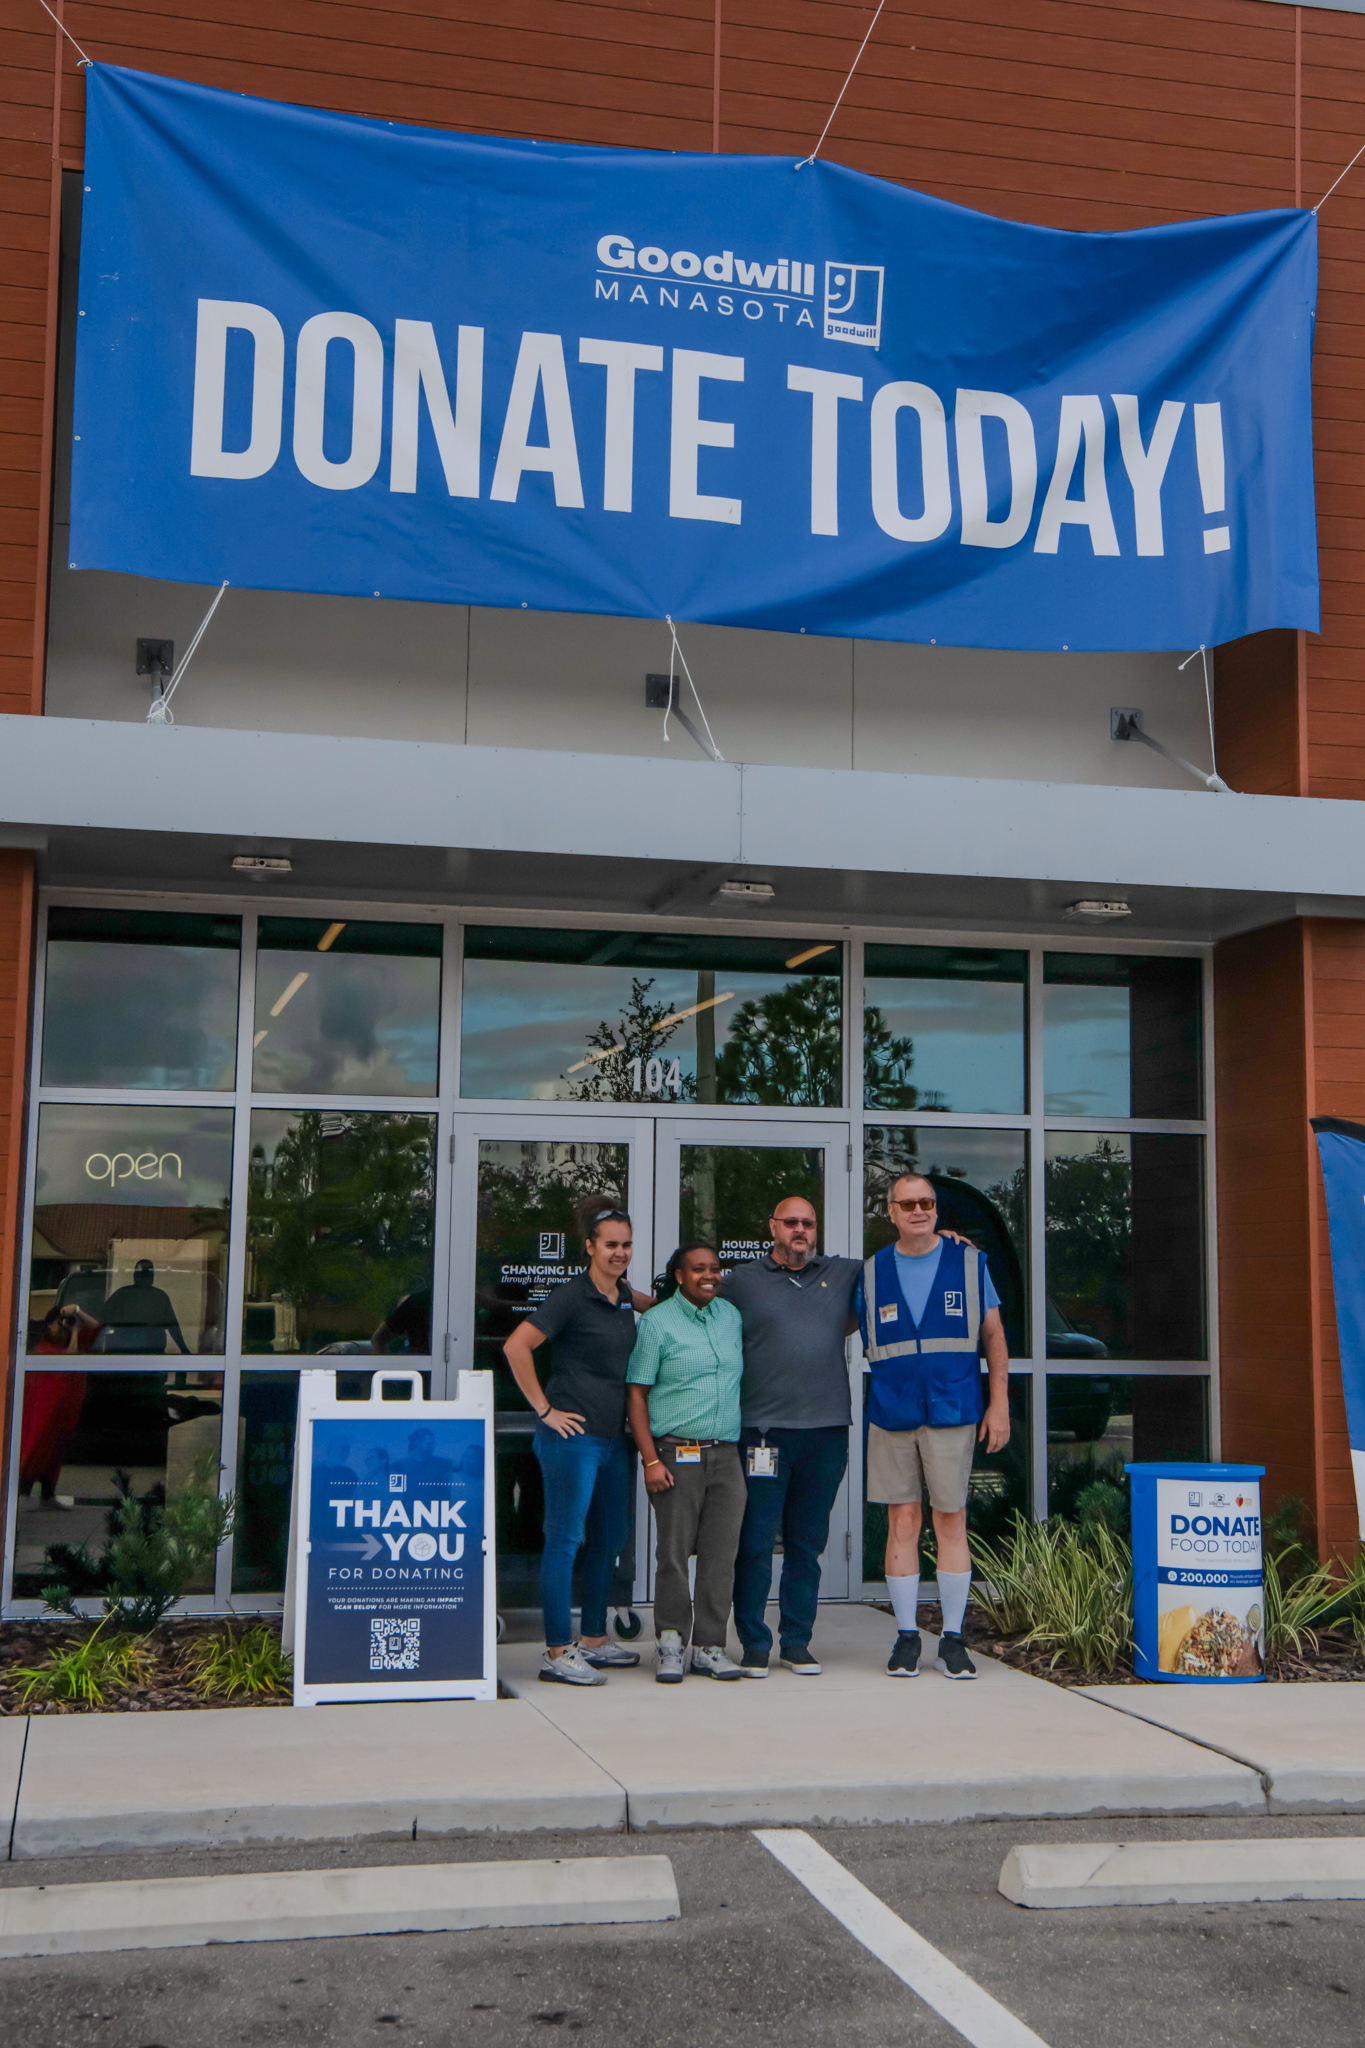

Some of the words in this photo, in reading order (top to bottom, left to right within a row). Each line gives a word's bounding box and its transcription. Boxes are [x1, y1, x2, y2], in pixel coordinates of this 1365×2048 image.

[596, 234, 815, 296] Goodwill
[595, 279, 814, 329] MANASOTA
[827, 324, 877, 339] goodwill
[190, 298, 745, 525] DONATE
[787, 364, 1231, 556] TODAY!
[625, 1057, 682, 1094] 104
[85, 1152, 182, 1187] open
[722, 1240, 760, 1249] HOURS
[501, 1265, 565, 1275] CHANGING
[501, 1275, 532, 1285] through
[533, 1275, 546, 1283] the
[546, 1277, 571, 1285] power
[329, 1499, 467, 1528] THANK
[1171, 1514, 1259, 1537] DONATE
[382, 1533, 464, 1562] YOU
[1171, 1538, 1219, 1553] FOOD
[329, 1567, 363, 1580] FOR
[372, 1567, 464, 1580] DONATING
[1180, 1571, 1229, 1585] 200,000
